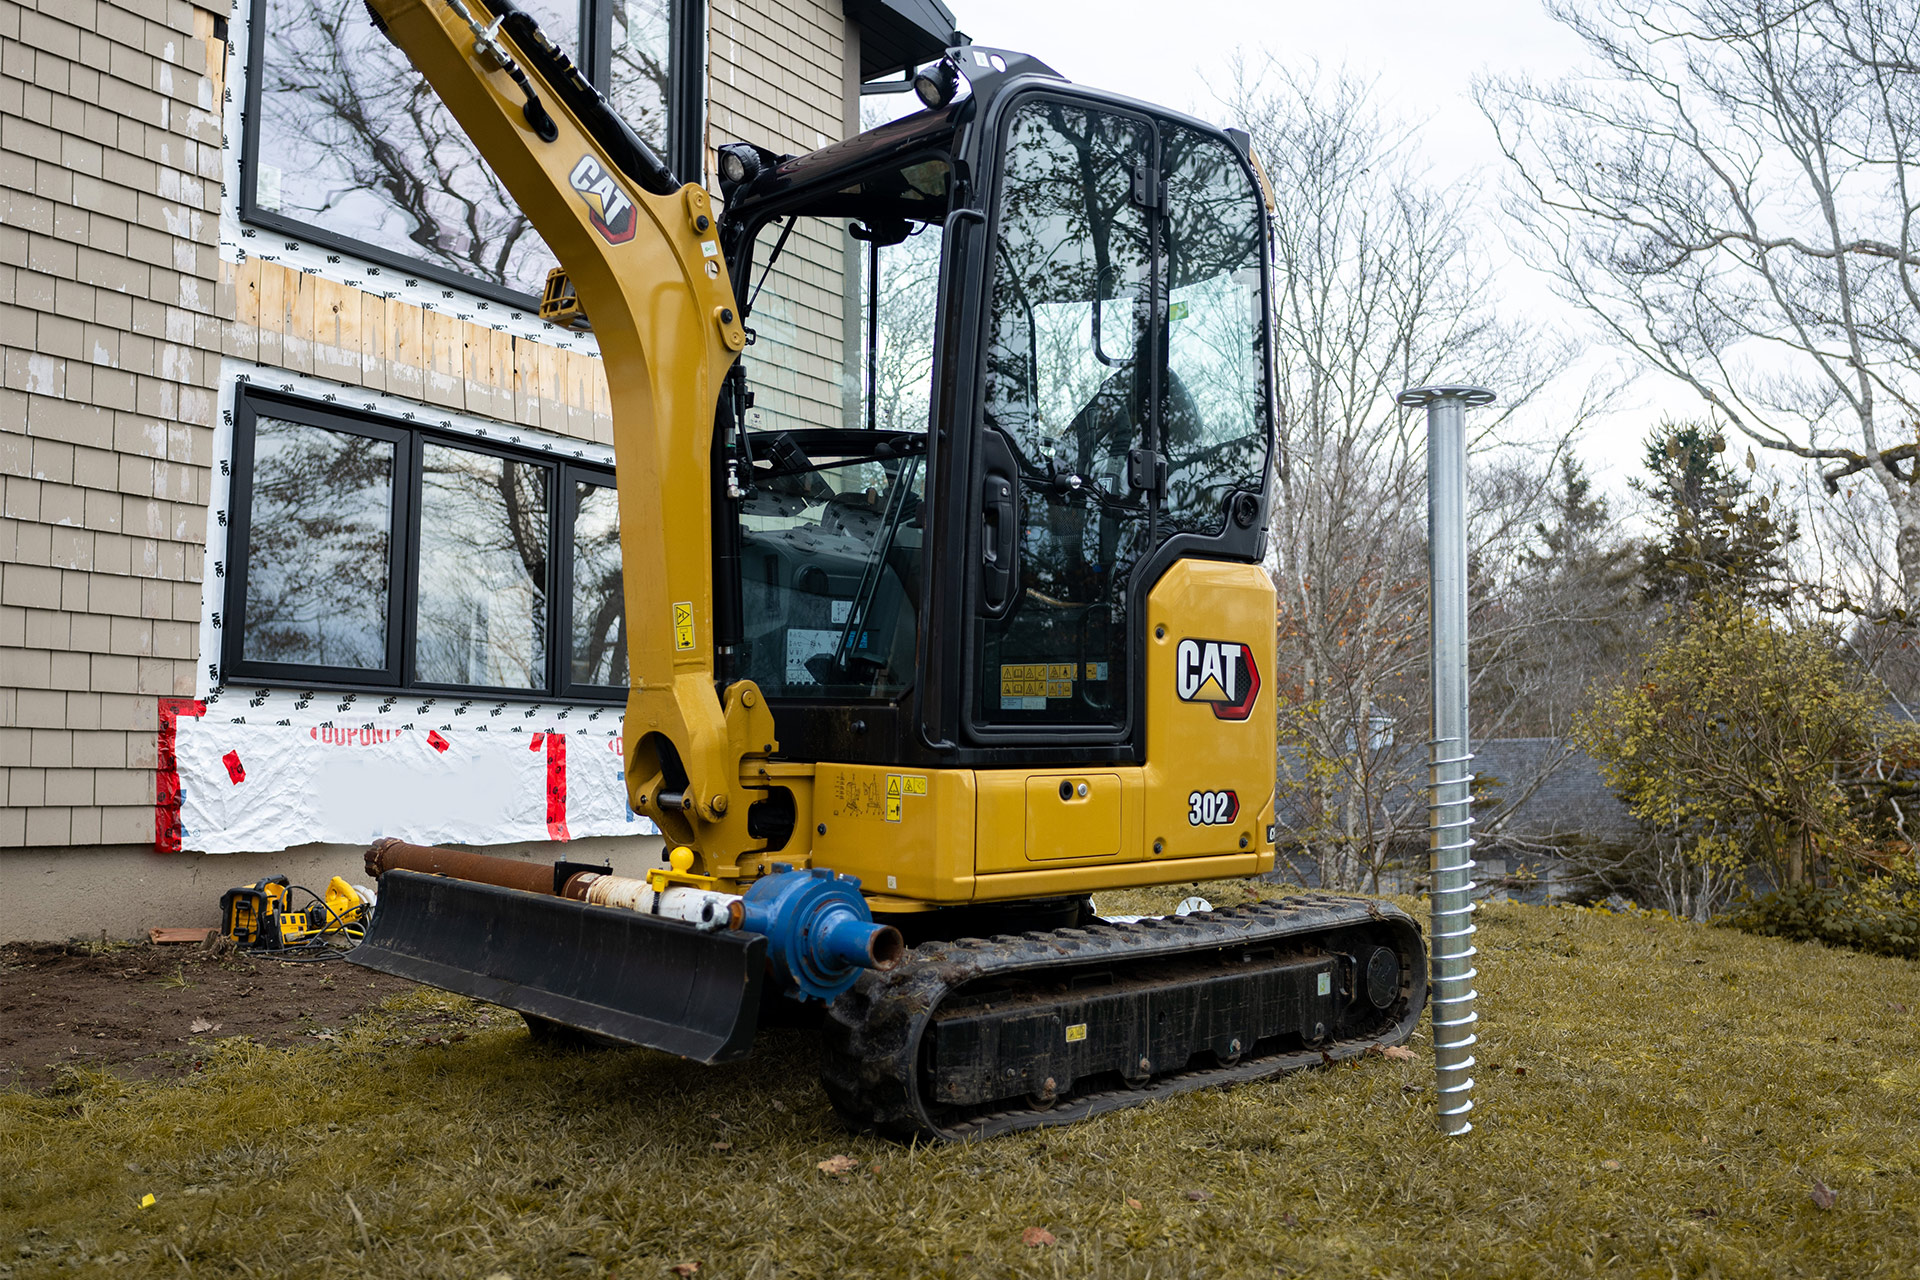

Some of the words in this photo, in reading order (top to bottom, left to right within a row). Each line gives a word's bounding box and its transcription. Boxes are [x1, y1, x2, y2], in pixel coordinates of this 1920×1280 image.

[570, 155, 632, 226] CAT
[222, 409, 232, 426] 3M
[220, 459, 230, 476] 3M
[217, 510, 227, 527] 3M
[214, 561, 224, 578] 3M
[211, 612, 222, 629] 3M
[208, 663, 219, 681] 3M
[1178, 639, 1241, 701] CAT
[1189, 791, 1228, 824] 302
